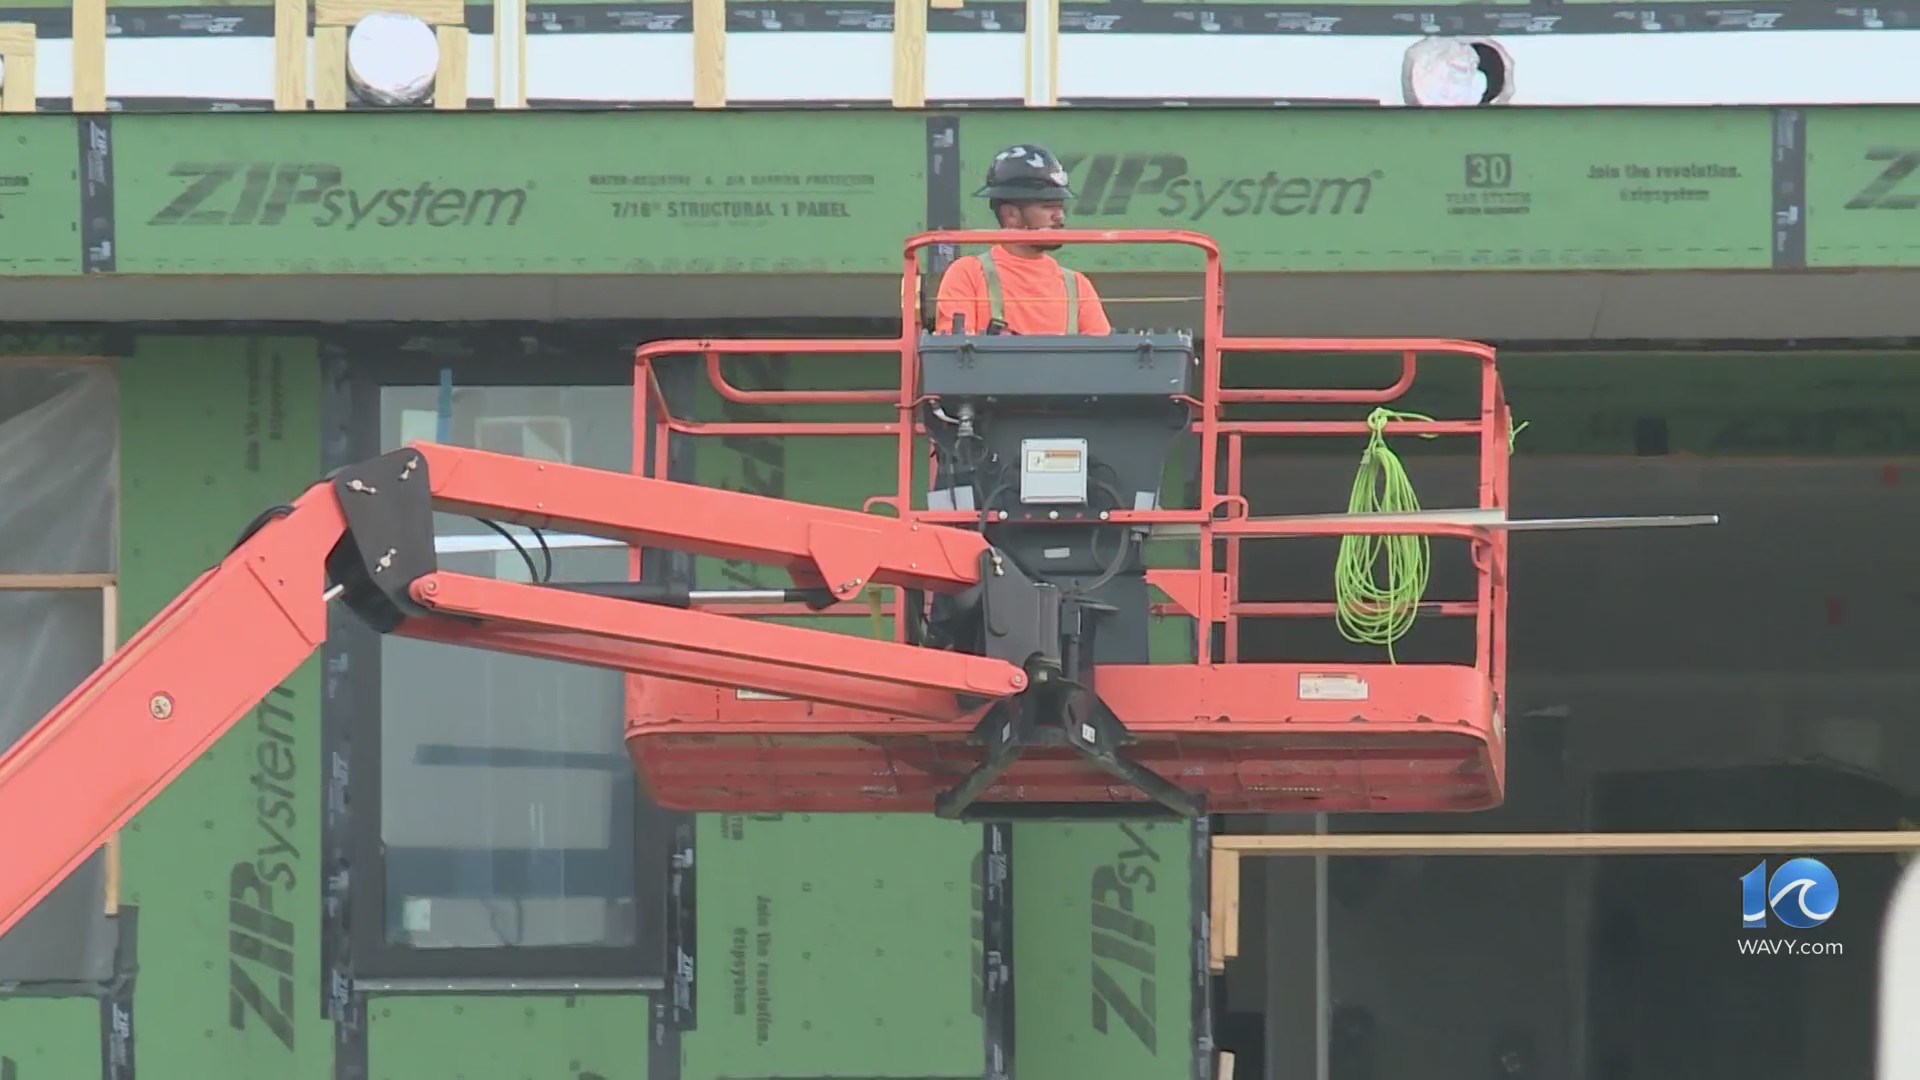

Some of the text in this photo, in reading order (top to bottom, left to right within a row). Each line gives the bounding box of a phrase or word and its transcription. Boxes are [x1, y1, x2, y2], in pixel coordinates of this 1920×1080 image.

[1471, 156, 1508, 184] 30
[1587, 164, 1620, 179] Join
[1625, 164, 1650, 178] the
[1058, 153, 1373, 221] IPsystem
[667, 201, 775, 218] STRUCTURAL
[796, 201, 851, 218] PANEL
